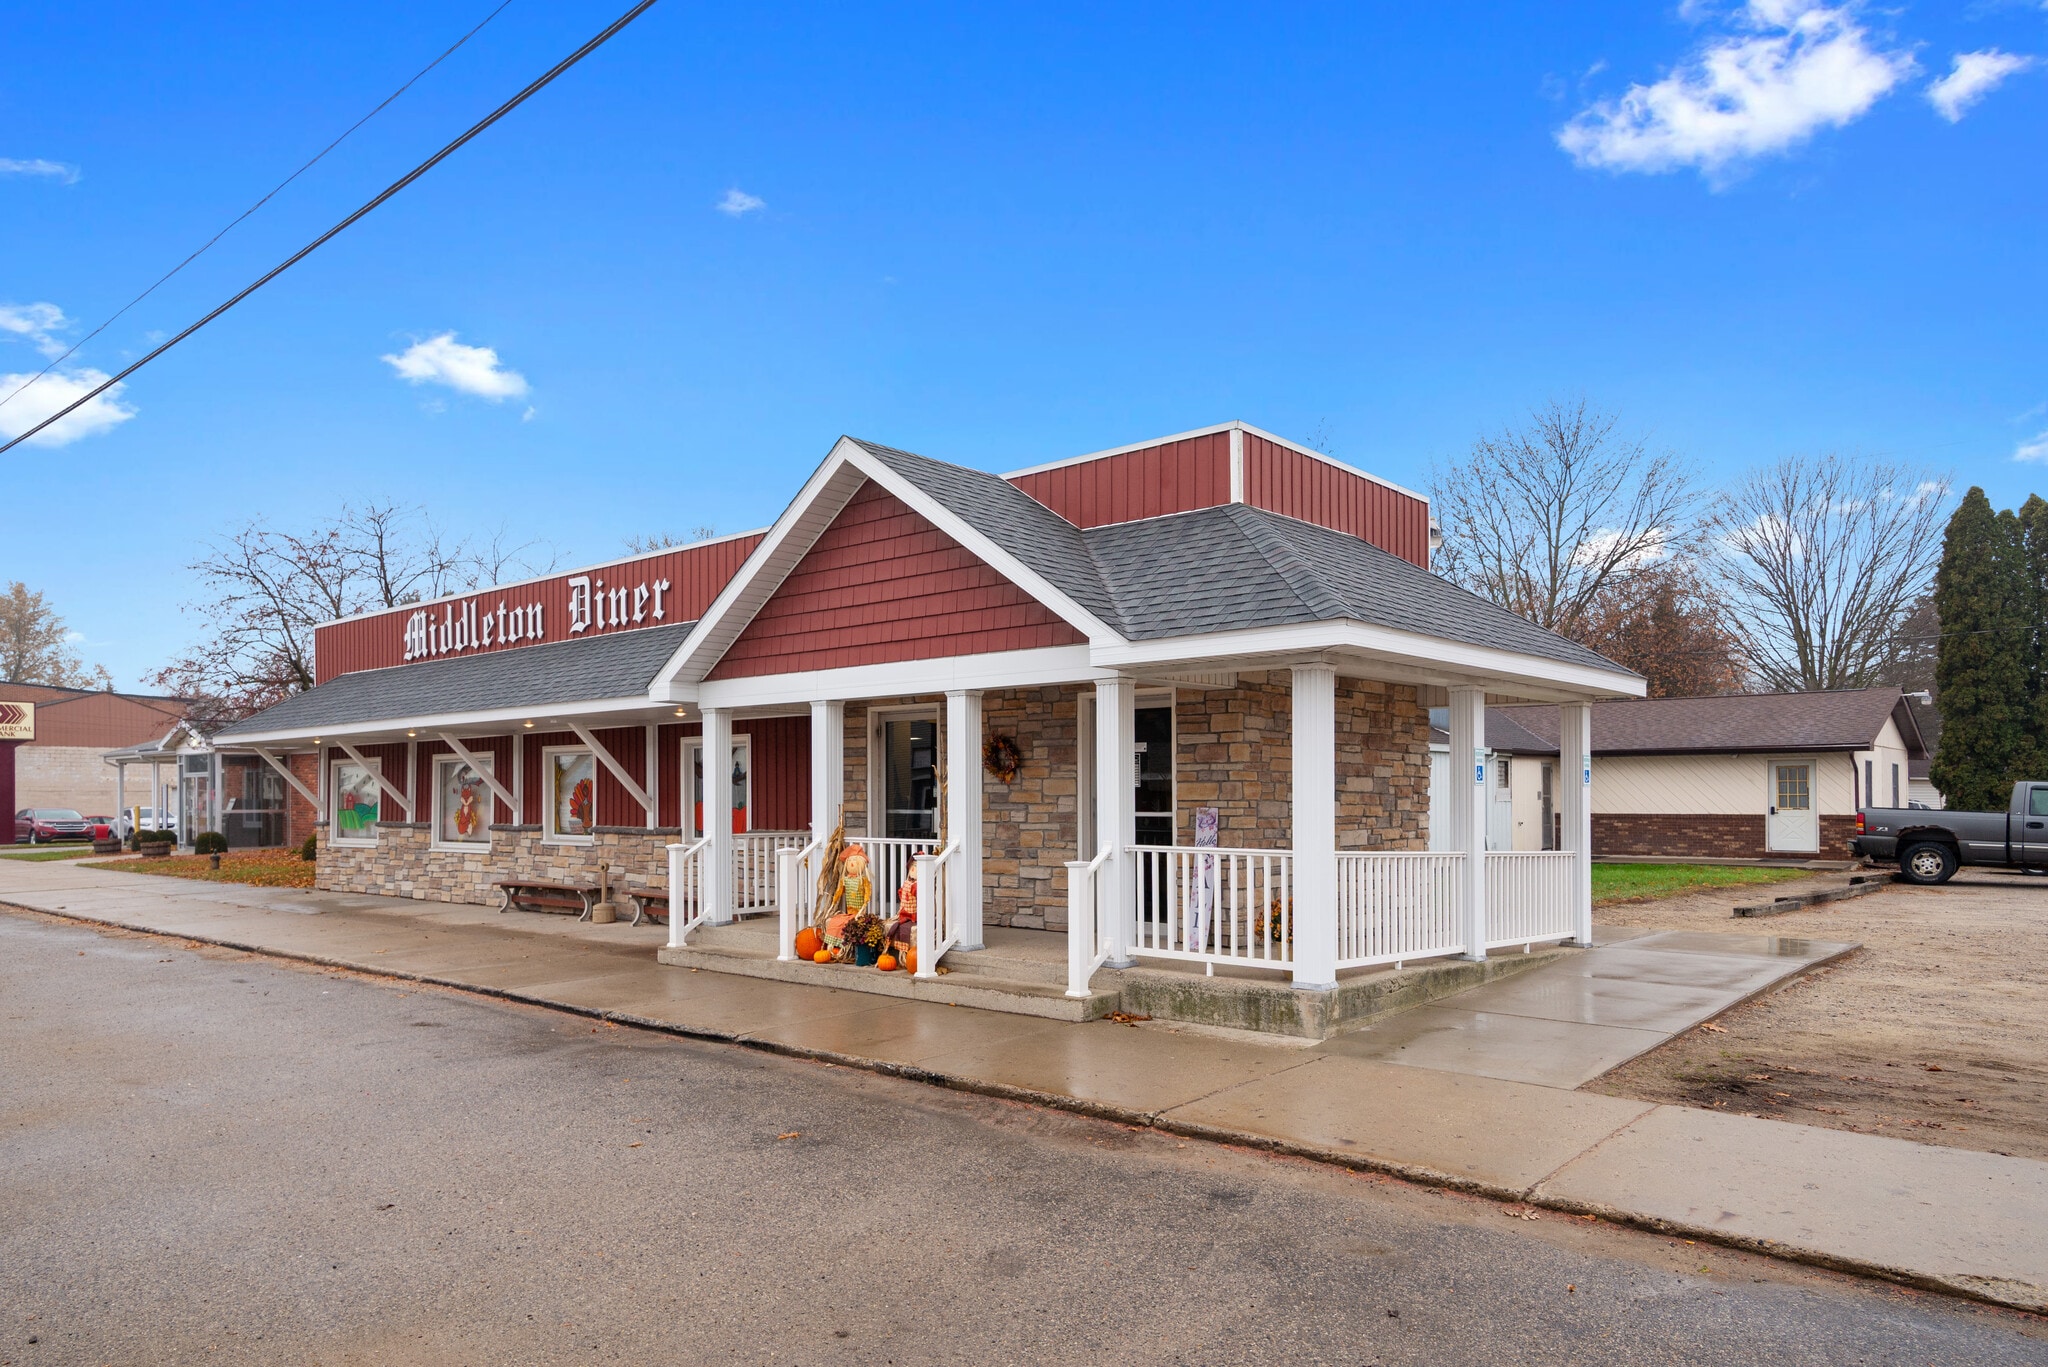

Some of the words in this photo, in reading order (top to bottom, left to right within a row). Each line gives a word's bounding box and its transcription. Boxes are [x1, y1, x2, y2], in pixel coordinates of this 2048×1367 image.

[403, 599, 545, 661] Middleton
[567, 575, 671, 634] Diner
[1196, 834, 1217, 848] Hello
